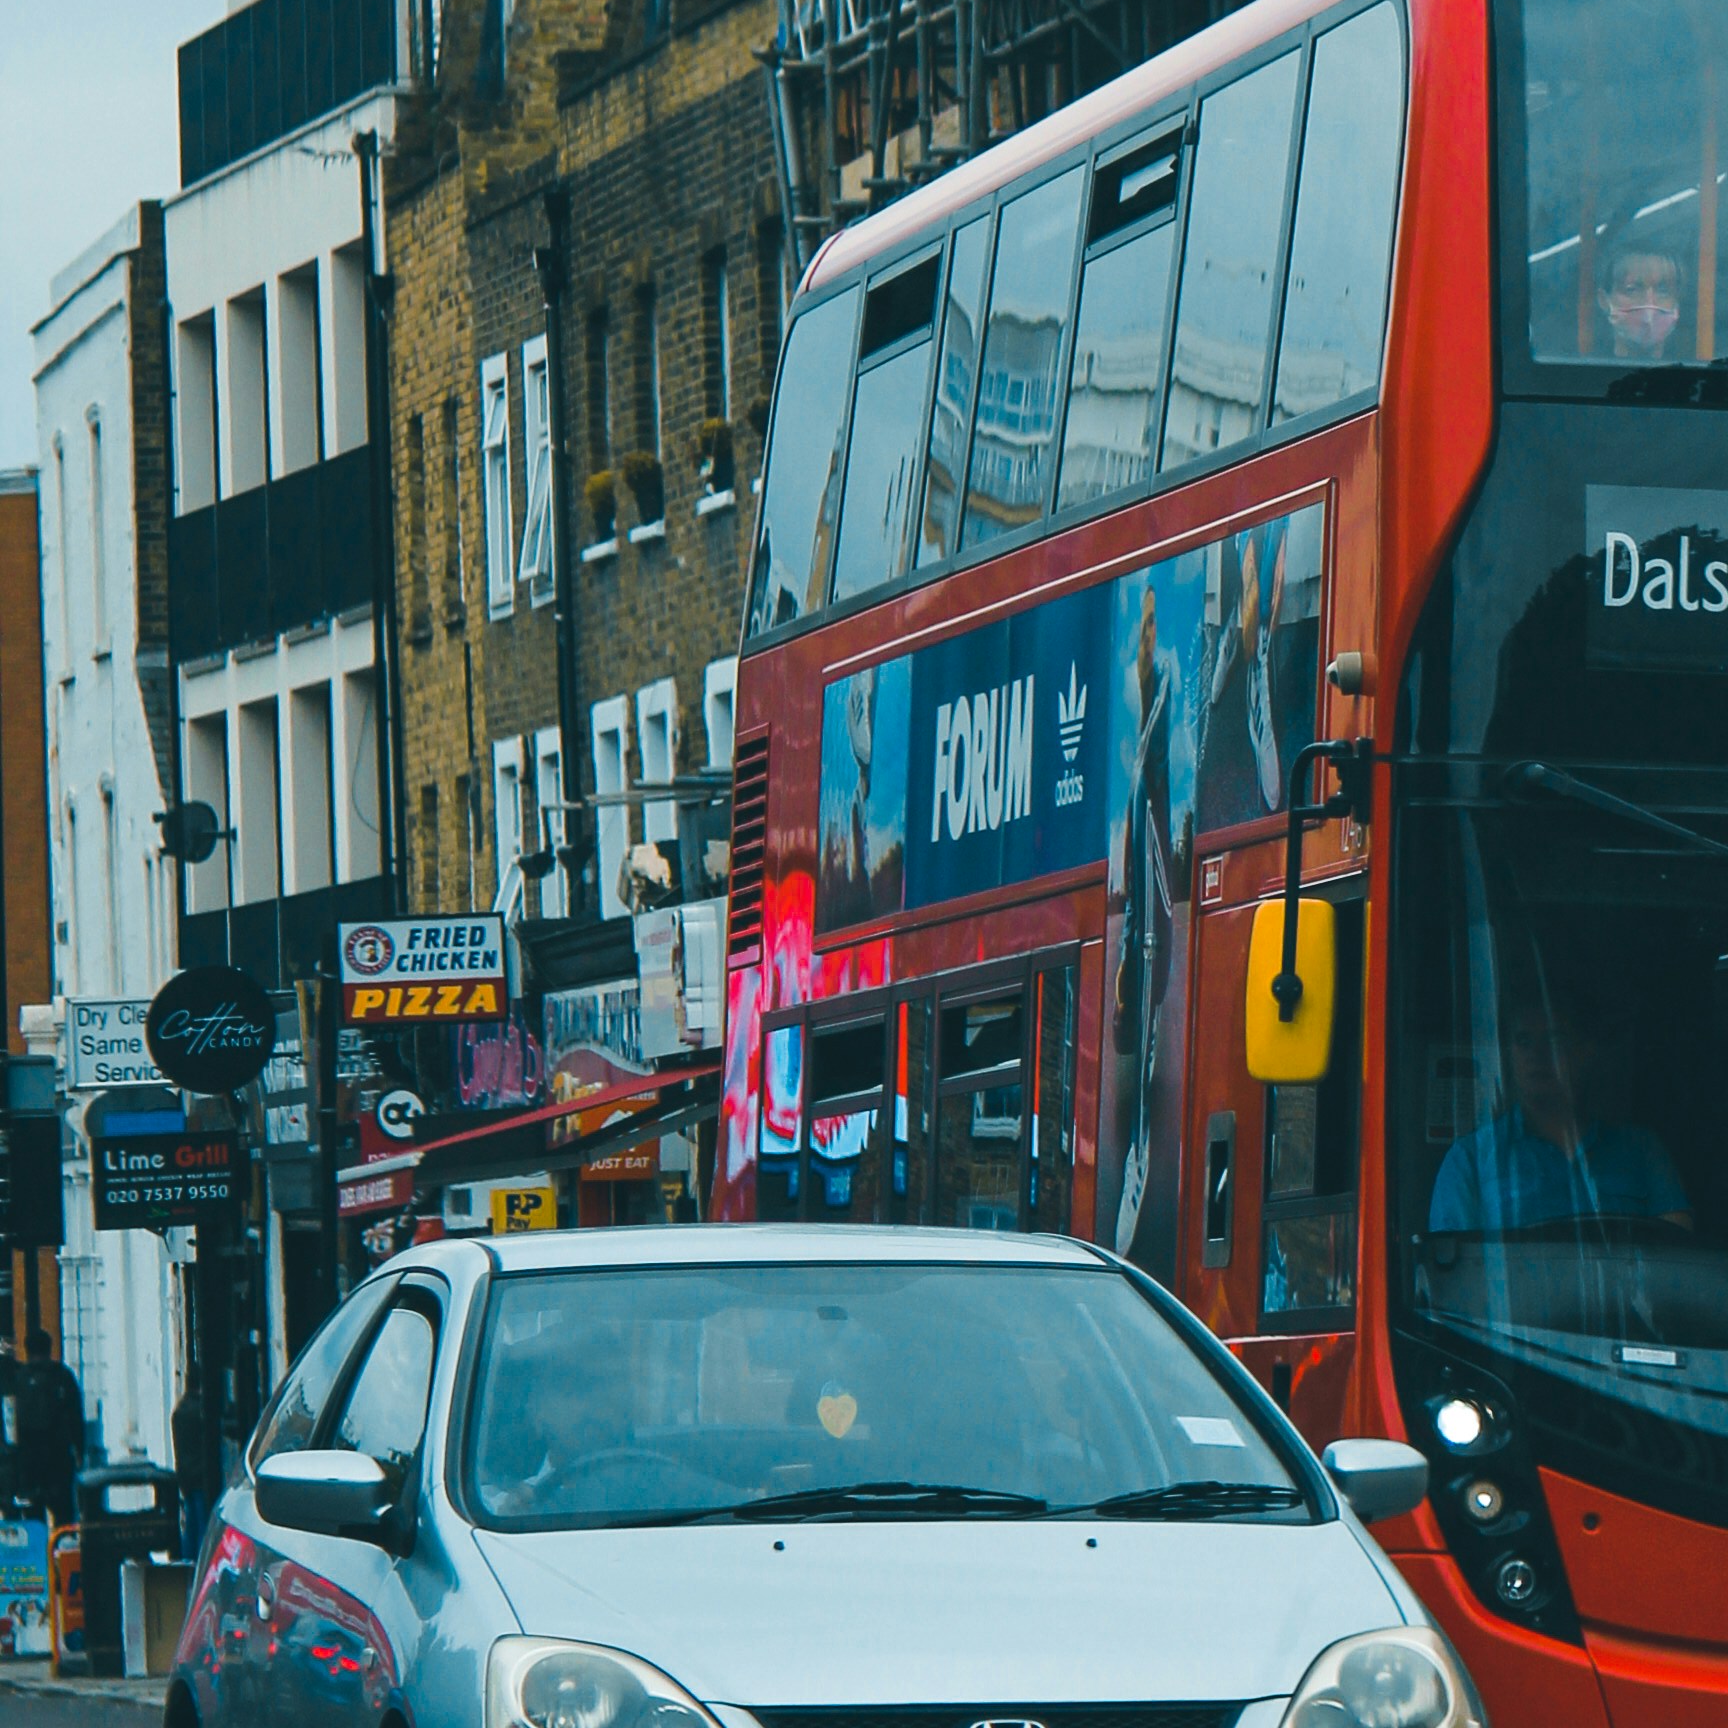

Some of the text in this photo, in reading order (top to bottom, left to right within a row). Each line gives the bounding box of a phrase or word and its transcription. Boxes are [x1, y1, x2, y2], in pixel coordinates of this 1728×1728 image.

[931, 673, 1035, 843] FORUM
[407, 925, 487, 950] FRIED
[396, 949, 498, 973] CHICKEN
[351, 983, 498, 1019] PIZZA
[77, 1005, 147, 1031] Dry Cle
[159, 1002, 266, 1055] Cotton
[80, 1035, 142, 1056] Same
[208, 1036, 262, 1048] CANDY
[95, 1061, 168, 1083] Servic
[104, 1143, 229, 1171] Lime Grill
[590, 1156, 649, 1171] JUST EAT
[107, 1184, 229, 1204] 020 7537 9550
